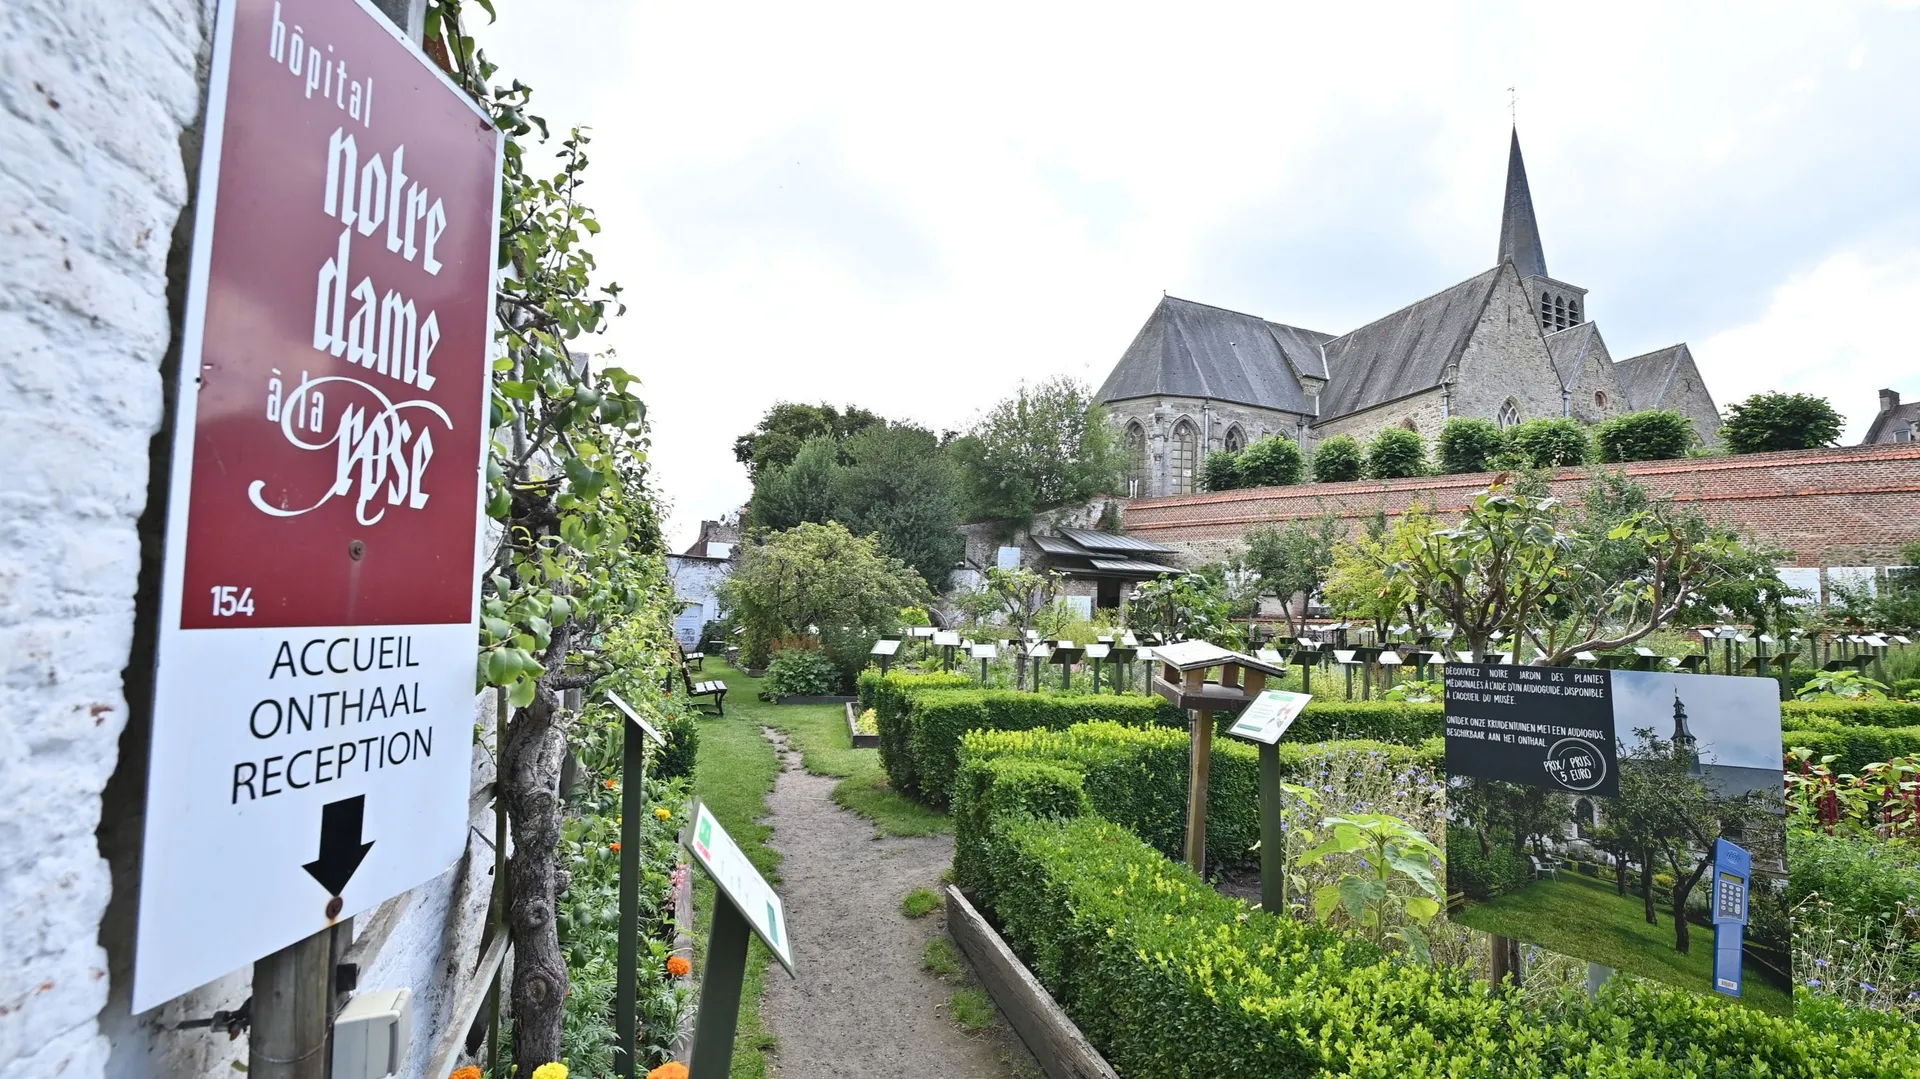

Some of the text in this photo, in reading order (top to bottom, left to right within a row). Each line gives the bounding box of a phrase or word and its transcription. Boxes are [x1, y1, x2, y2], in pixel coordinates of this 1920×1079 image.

[269, 1, 372, 128] hôpital
[324, 126, 447, 276] notre
[313, 229, 440, 391] dame
[267, 369, 324, 433] à la
[210, 585, 255, 617] 154
[268, 636, 420, 680] ACCUEIL
[1445, 666, 1604, 684] DÉCOUVREZ NOTRE JARDIN DES PLANTES
[1446, 678, 1484, 690] MÉDICINALES
[1484, 680, 1489, 690] À
[1564, 686, 1604, 698] DISPONIBLE
[1483, 694, 1491, 703] DU
[249, 682, 427, 740] ONTHAAL
[1446, 715, 1469, 726] ONTDEK
[1470, 718, 1486, 728] ONZE
[1487, 719, 1536, 733] KRUIDENTUINEN
[1536, 724, 1551, 735] MET
[1552, 725, 1566, 736] EEN
[1446, 728, 1485, 740] BESCHIKBAAR
[1488, 732, 1501, 742] AAN
[1503, 733, 1515, 744] HET
[231, 726, 433, 804] RECEPTION
[1560, 768, 1592, 782] 5 EURO
